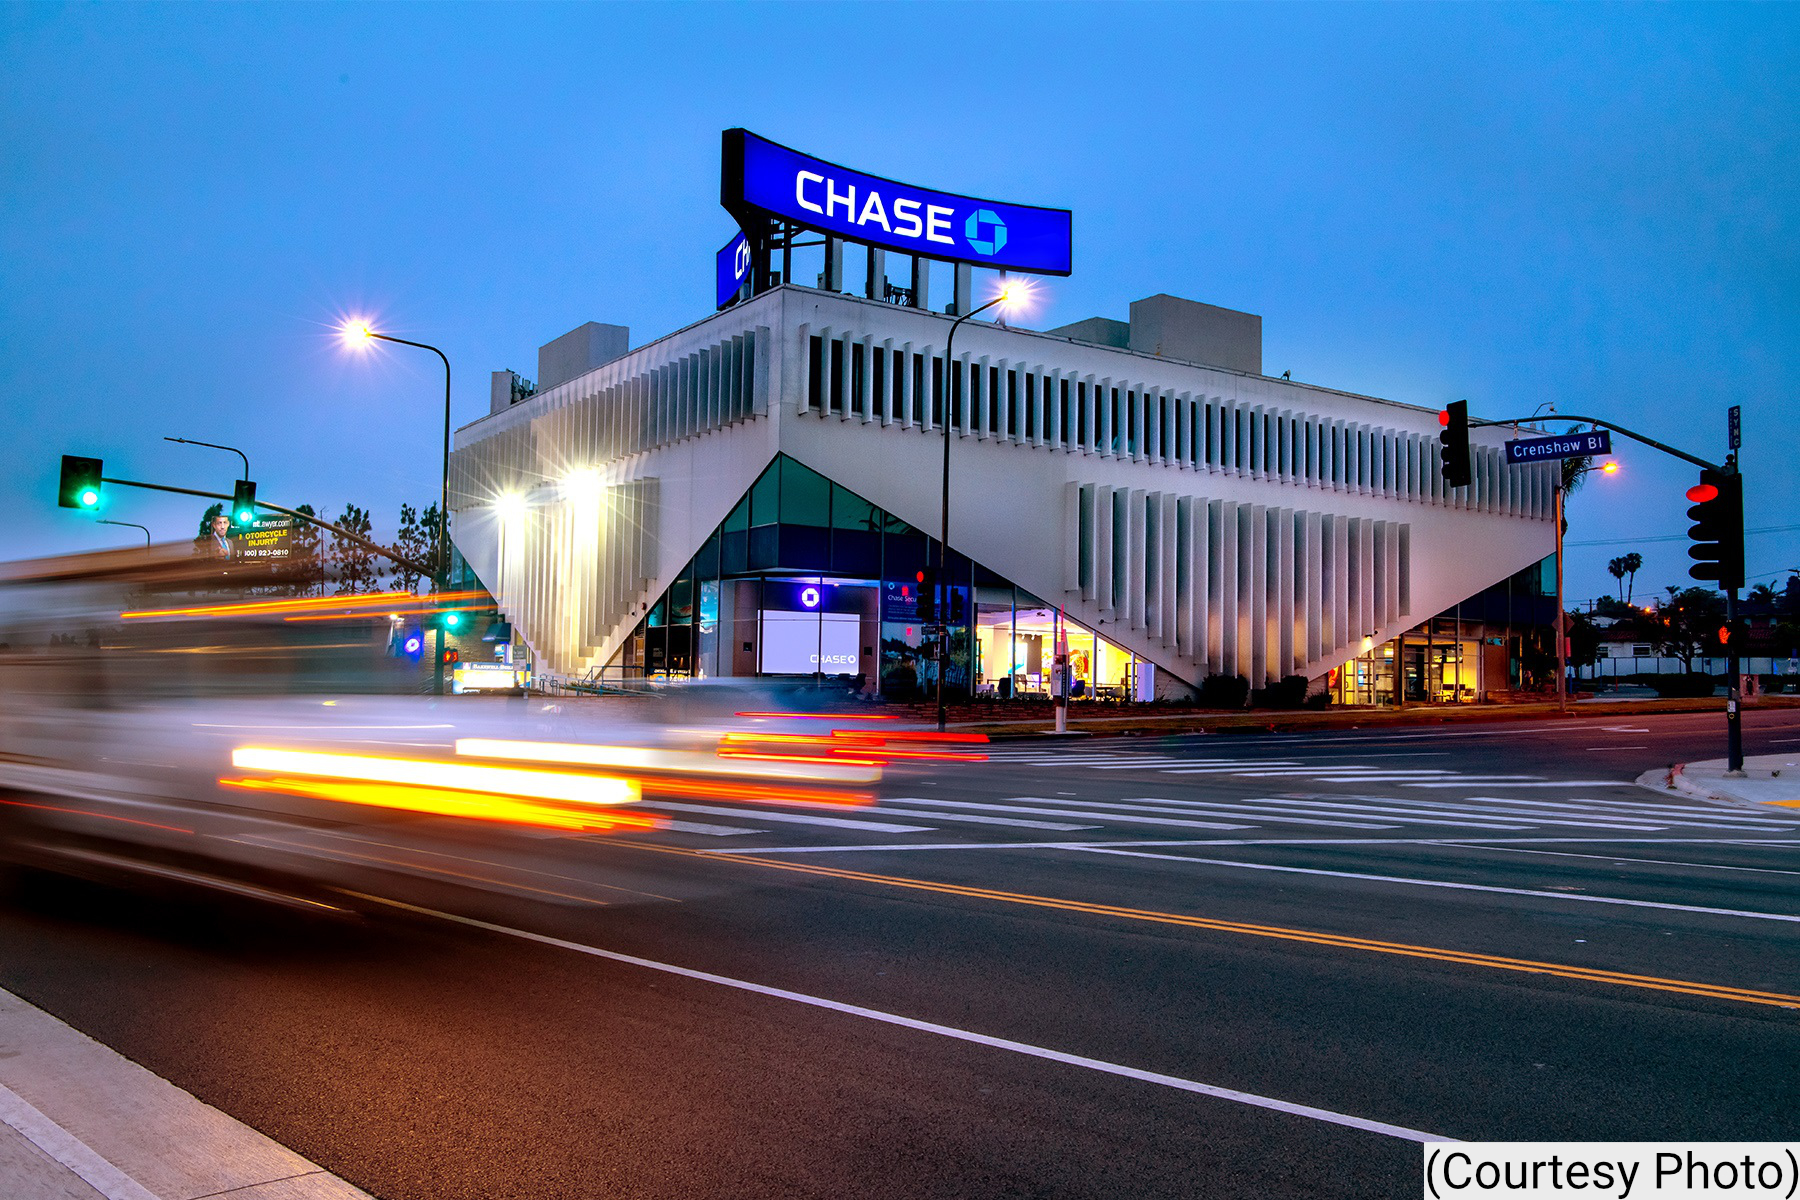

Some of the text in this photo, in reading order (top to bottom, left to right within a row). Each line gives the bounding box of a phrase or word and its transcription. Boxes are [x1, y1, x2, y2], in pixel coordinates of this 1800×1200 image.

[795, 170, 955, 245] CHASE
[1513, 441, 1581, 457] Crenshaw
[248, 538, 279, 547] INJURY?
[887, 594, 904, 602] Chase
[810, 654, 848, 664] CHASE
